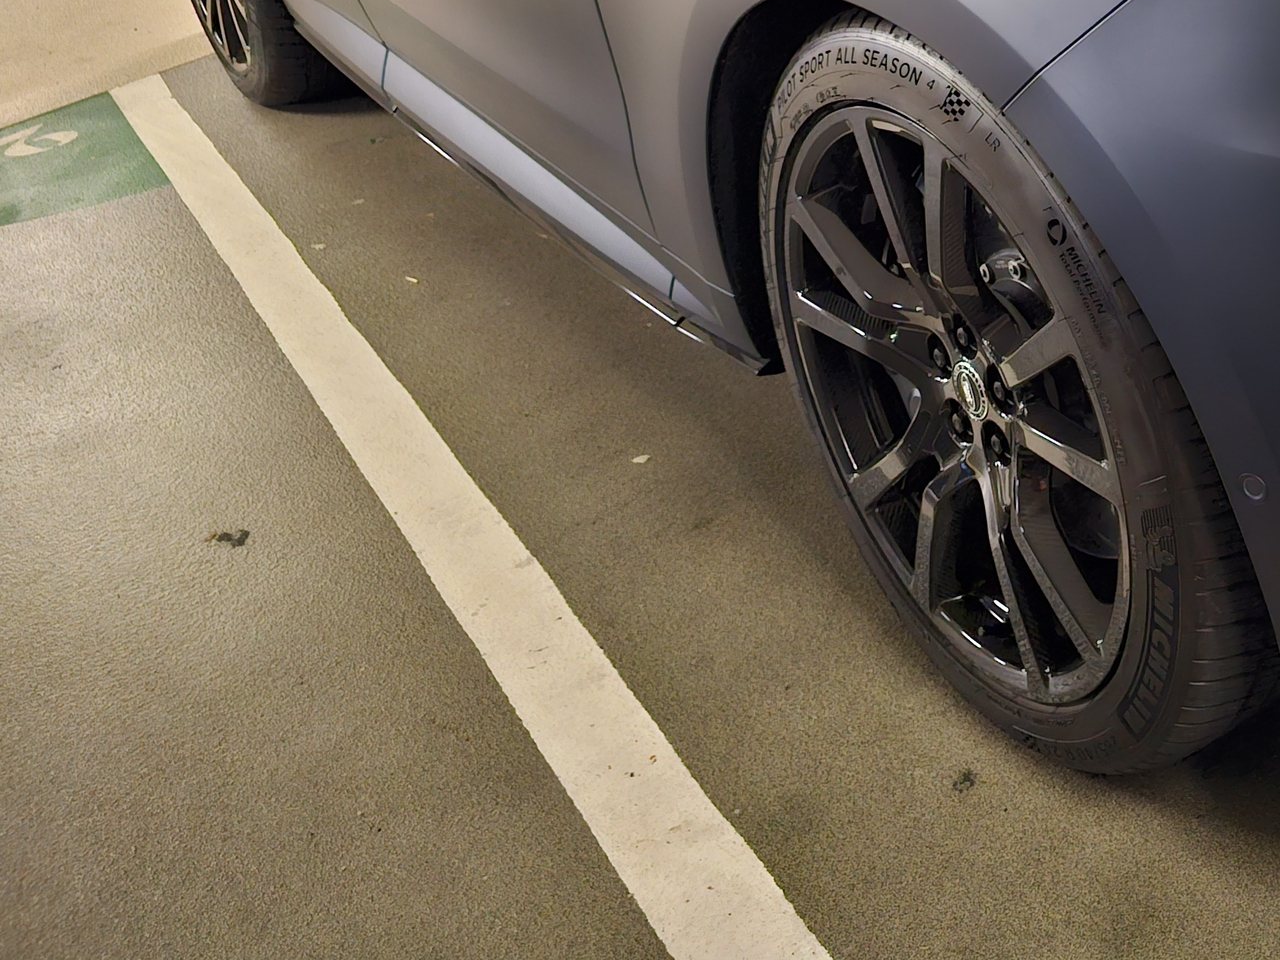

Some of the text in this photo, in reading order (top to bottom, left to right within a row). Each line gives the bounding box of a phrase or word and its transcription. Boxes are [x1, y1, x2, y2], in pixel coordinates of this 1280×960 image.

[800, 49, 831, 83] SPORT
[836, 46, 857, 65] ALL
[863, 48, 922, 86] SEASON
[927, 79, 936, 91] 4
[985, 131, 1001, 152] LR
[1059, 252, 1076, 278] Total
[1066, 246, 1106, 315] MICHELIN
[1122, 575, 1174, 734] MICHELIN
